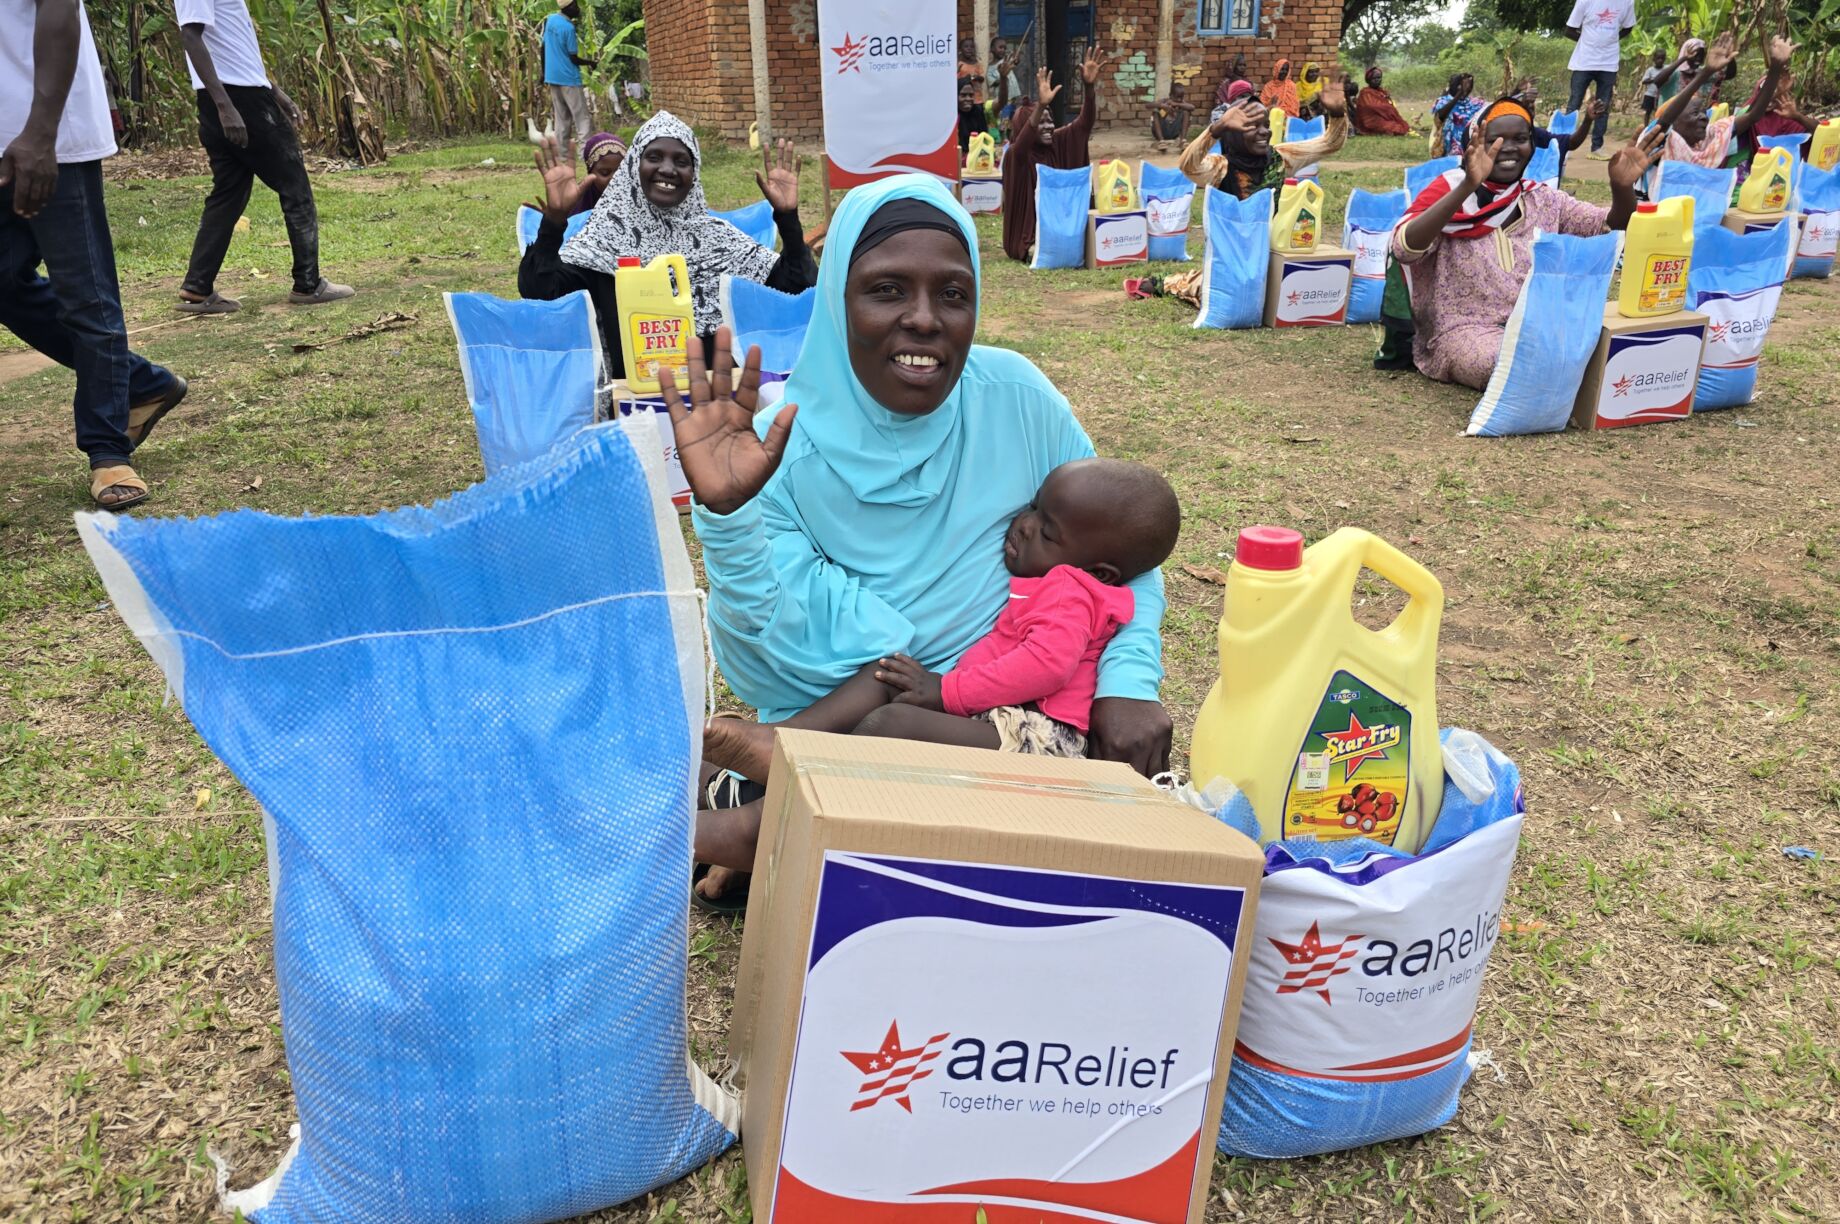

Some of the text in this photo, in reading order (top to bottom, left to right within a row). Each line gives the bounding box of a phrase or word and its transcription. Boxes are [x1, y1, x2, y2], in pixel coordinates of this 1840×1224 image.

[869, 34, 953, 56] aaRelief
[1652, 258, 1687, 272] BEST
[1654, 272, 1682, 285] FRY
[1303, 289, 1341, 300] aaRelief
[639, 319, 681, 335] BEST
[645, 335, 678, 350] FRY
[1635, 368, 1689, 387] aaRelief
[1333, 692, 1357, 700] TASCO
[1323, 724, 1400, 759] Star Fry
[1362, 909, 1501, 977] aaRelie
[1356, 986, 1425, 1007] Together
[1429, 979, 1445, 996] we
[1449, 967, 1472, 990] help
[946, 1037, 1179, 1089] aaRelief
[939, 1091, 1163, 1118] Together we help others
